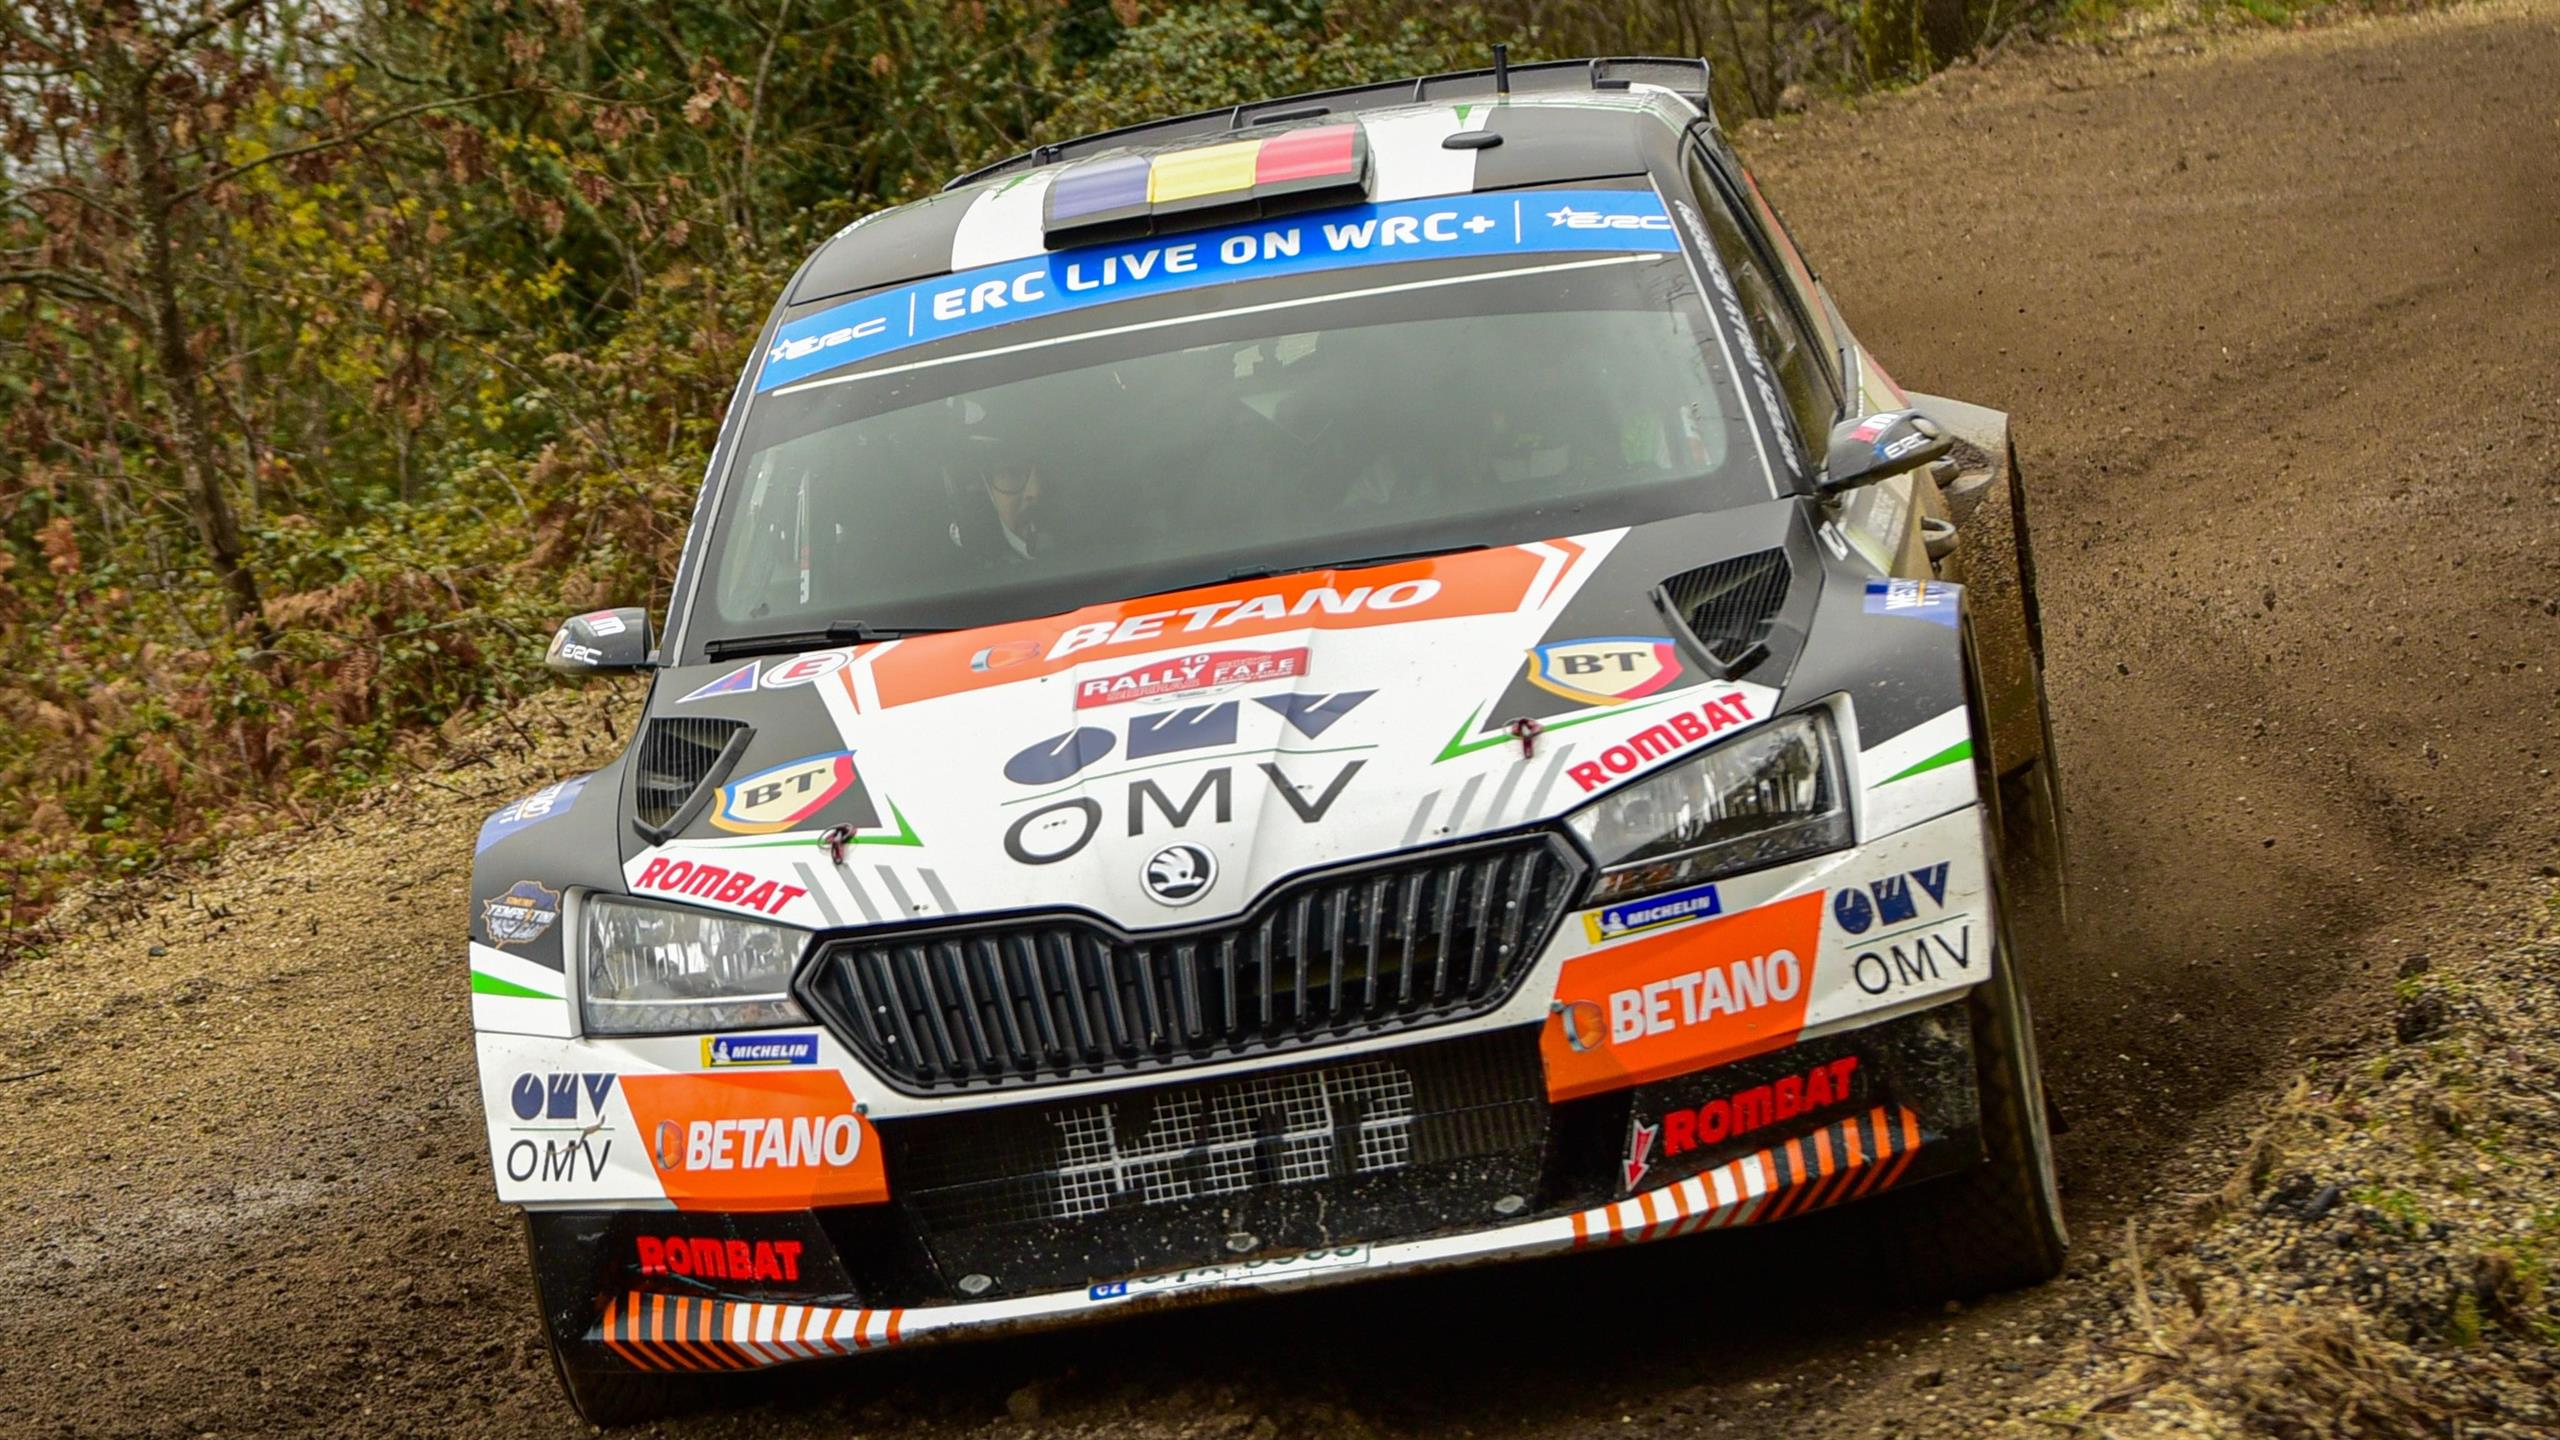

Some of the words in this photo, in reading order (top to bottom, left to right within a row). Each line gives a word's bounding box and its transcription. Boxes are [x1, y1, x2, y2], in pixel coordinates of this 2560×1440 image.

[1565, 211, 1672, 230] ERC
[932, 270, 1046, 322] ERC
[1065, 243, 1199, 292] LIVE
[1219, 228, 1301, 265] ON
[1323, 211, 1496, 252] WRC+
[785, 316, 887, 361] ERC
[1043, 578, 1442, 661] BETANO
[562, 643, 603, 666] ERC
[782, 656, 833, 680] E
[1082, 664, 1206, 697] RALLY
[1214, 656, 1295, 682] FAFE
[1557, 650, 1648, 677] BT
[1565, 691, 1758, 793] ROMBAT
[741, 767, 827, 811] BT
[1002, 758, 1369, 866] OMV
[633, 856, 808, 916] ROMBAT
[1625, 894, 1712, 929] MICHELIN
[1853, 924, 1971, 995] OMV
[1609, 948, 1801, 1045] BETANO
[730, 1041, 810, 1060] MICHELIN
[1663, 1056, 1859, 1158] ROMBAT
[505, 1138, 612, 1184] OMV
[685, 1113, 862, 1171] BETANO
[635, 1235, 802, 1282] ROMBAT
[1095, 1284, 1124, 1297] CZ
